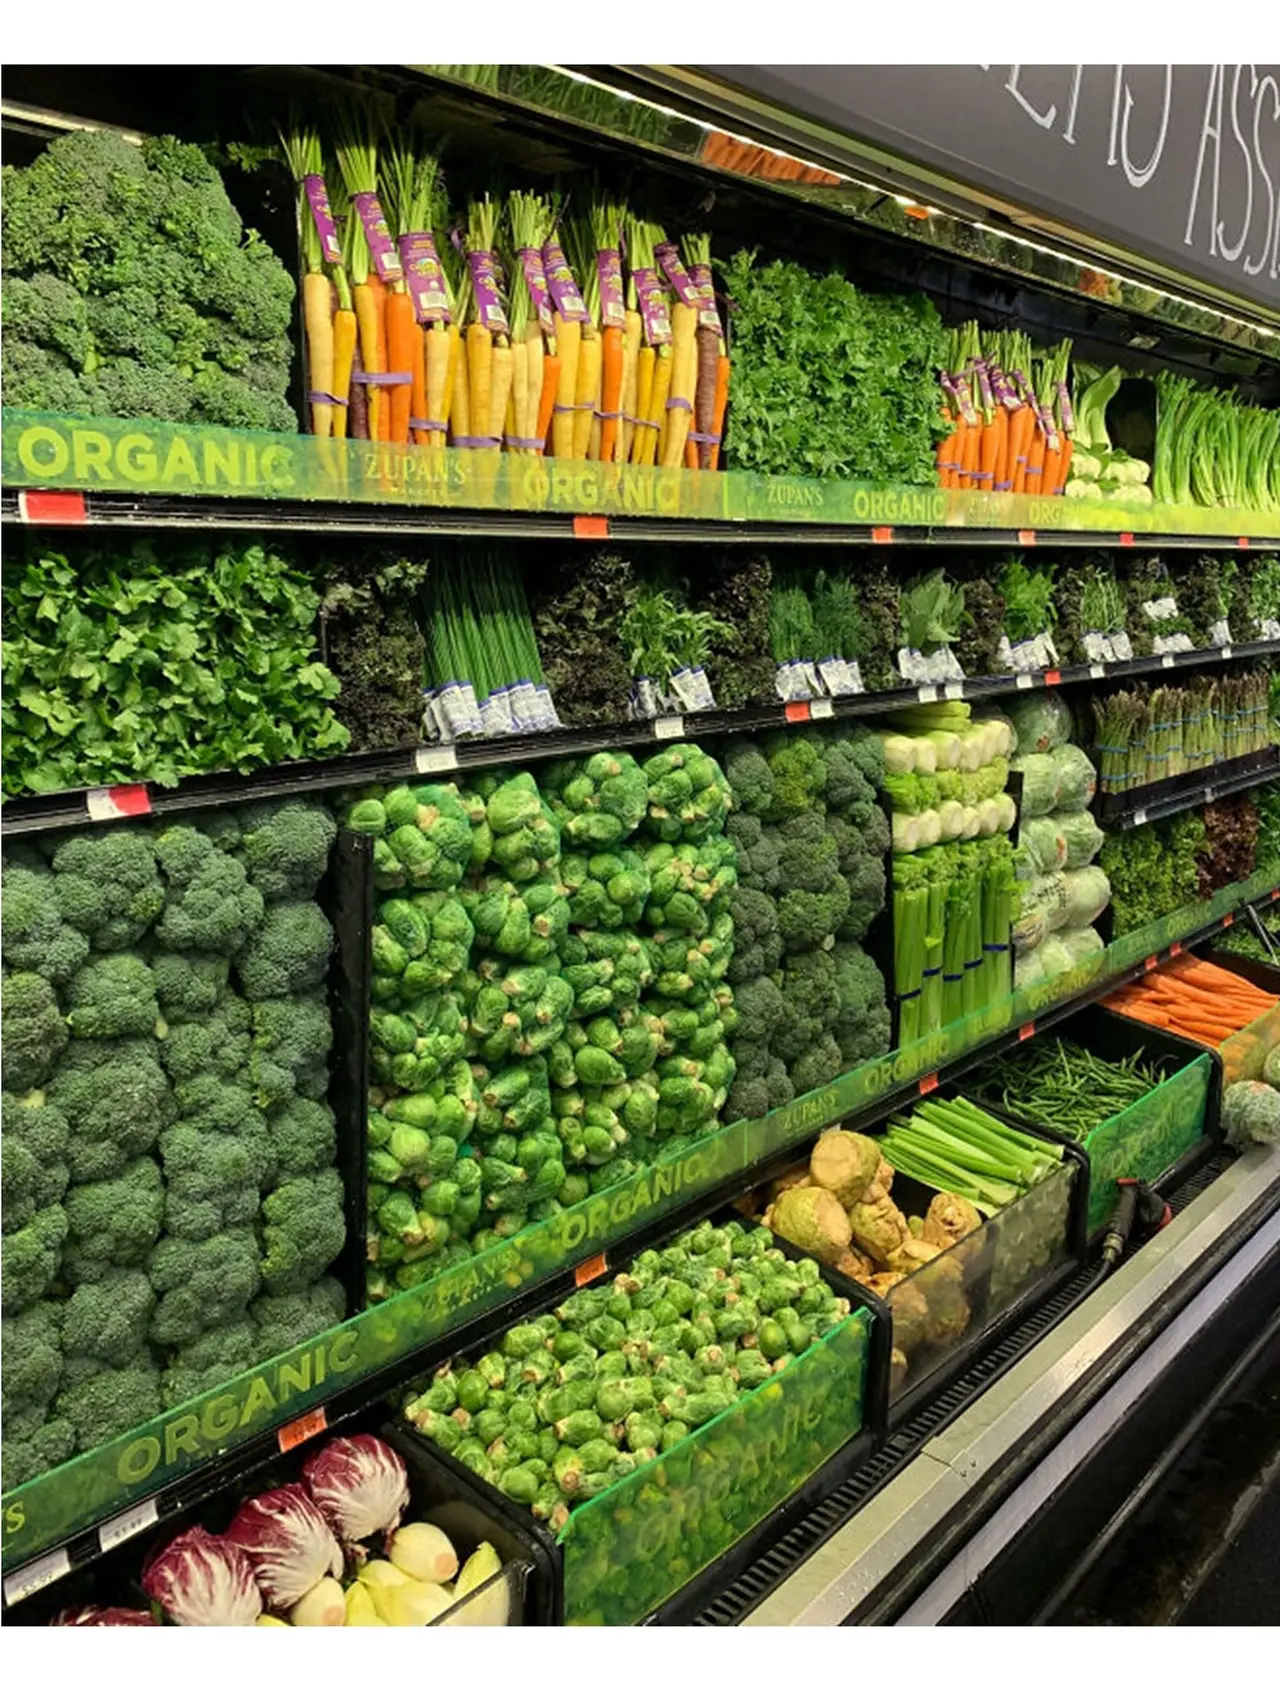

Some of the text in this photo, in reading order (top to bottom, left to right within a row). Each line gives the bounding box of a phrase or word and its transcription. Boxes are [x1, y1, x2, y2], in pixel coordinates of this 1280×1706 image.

[1184, 64, 1280, 280] ASS
[17, 425, 295, 490] ORGANIC
[365, 453, 466, 485] ZUPAN'S
[523, 467, 681, 512] ORGANIC
[854, 489, 945, 521] ORGANIC
[116, 1331, 359, 1485] ORGANIC
